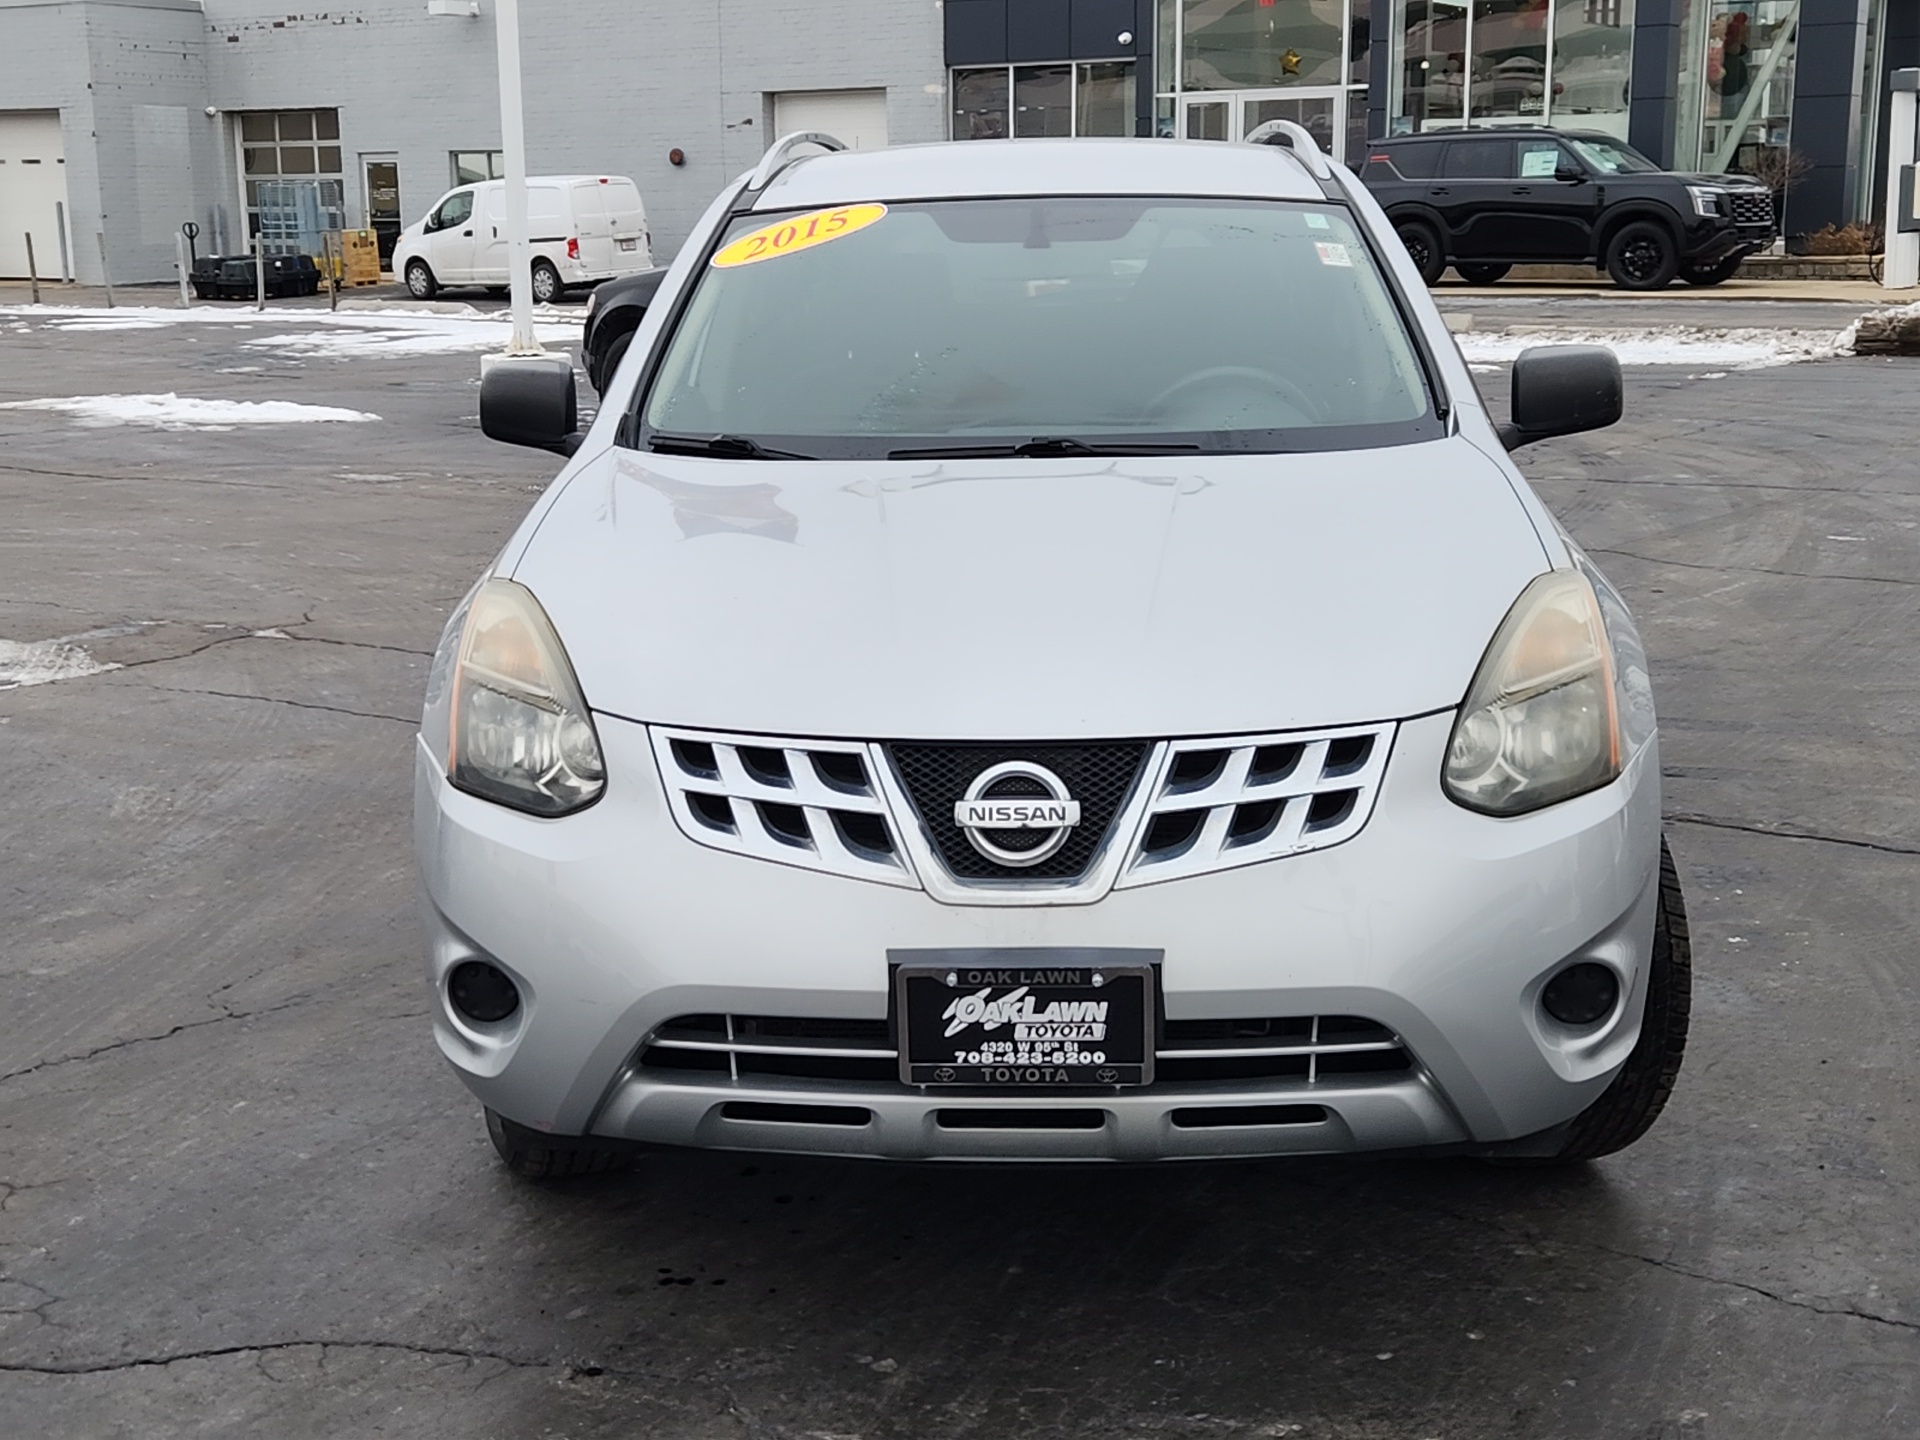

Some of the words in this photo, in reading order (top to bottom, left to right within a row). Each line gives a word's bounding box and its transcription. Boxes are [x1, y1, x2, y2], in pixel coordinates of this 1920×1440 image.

[744, 210, 849, 260] 2015
[969, 806, 1066, 822] NISSAN
[967, 971, 1012, 984] OAK
[1020, 971, 1081, 984] LAWN
[1024, 1025, 1095, 1038] TOYOTA
[980, 1041, 1013, 1053] 4320
[1017, 1041, 1031, 1052] W
[1064, 1041, 1079, 1053] St
[981, 1068, 1069, 1082] TOYOTA
